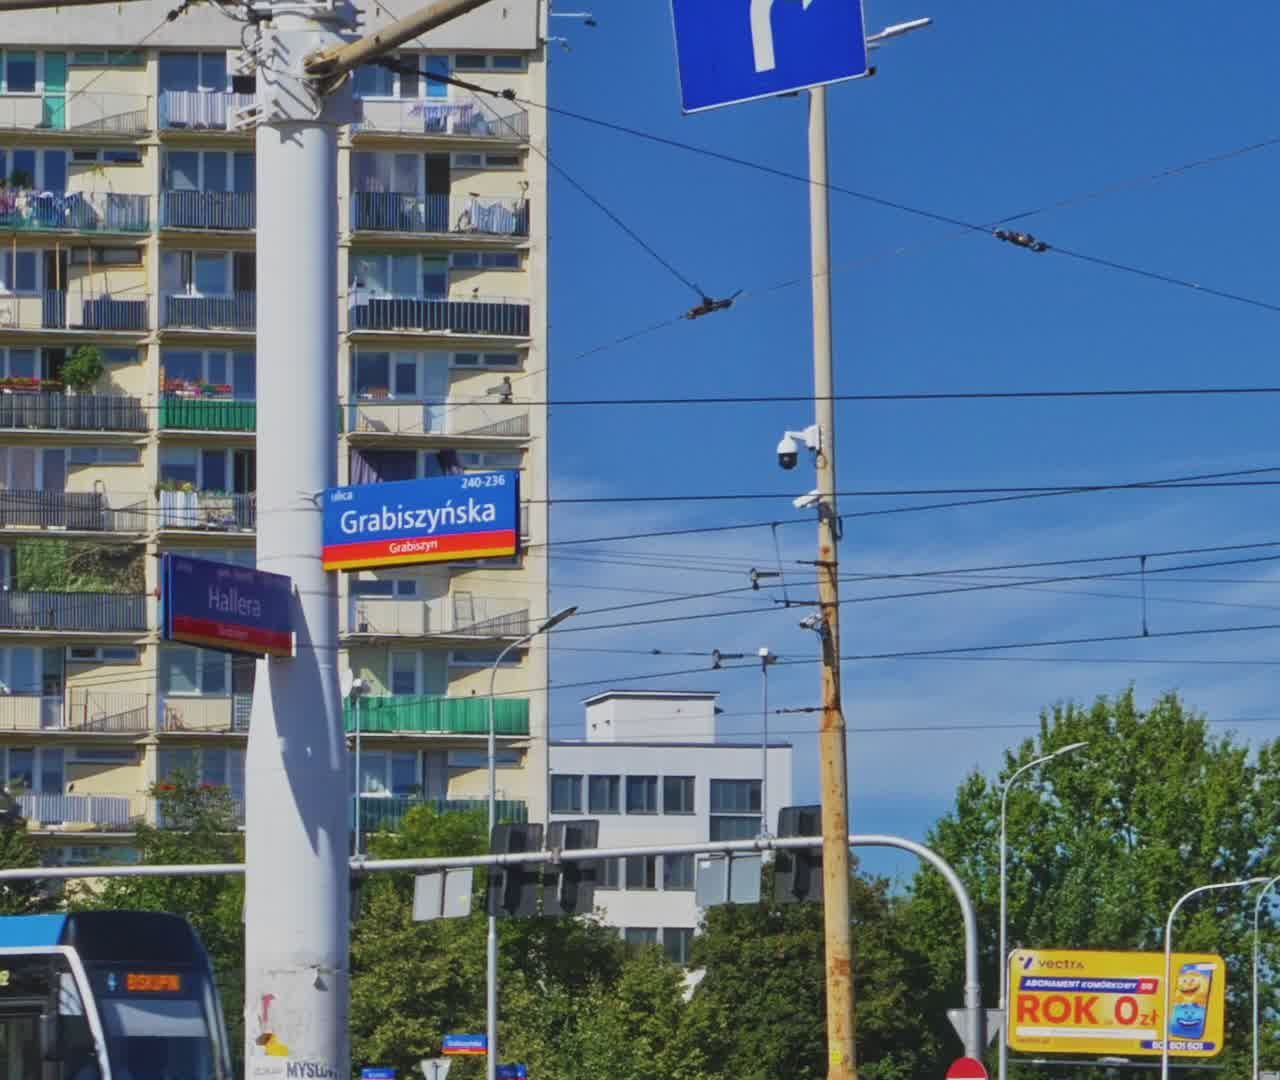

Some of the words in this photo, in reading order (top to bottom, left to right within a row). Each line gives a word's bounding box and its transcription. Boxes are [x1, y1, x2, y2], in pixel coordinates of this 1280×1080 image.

[461, 474, 505, 489] 240-236
[330, 490, 353, 502] ulica
[340, 498, 496, 534] Grabiszyńska
[389, 539, 438, 554] Grabiszyn
[207, 584, 261, 617] Hallera
[1039, 959, 1085, 969] vectra
[1025, 978, 1081, 989] ABONAMENT
[1017, 994, 1099, 1025] ROK
[1115, 996, 1139, 1026] 0
